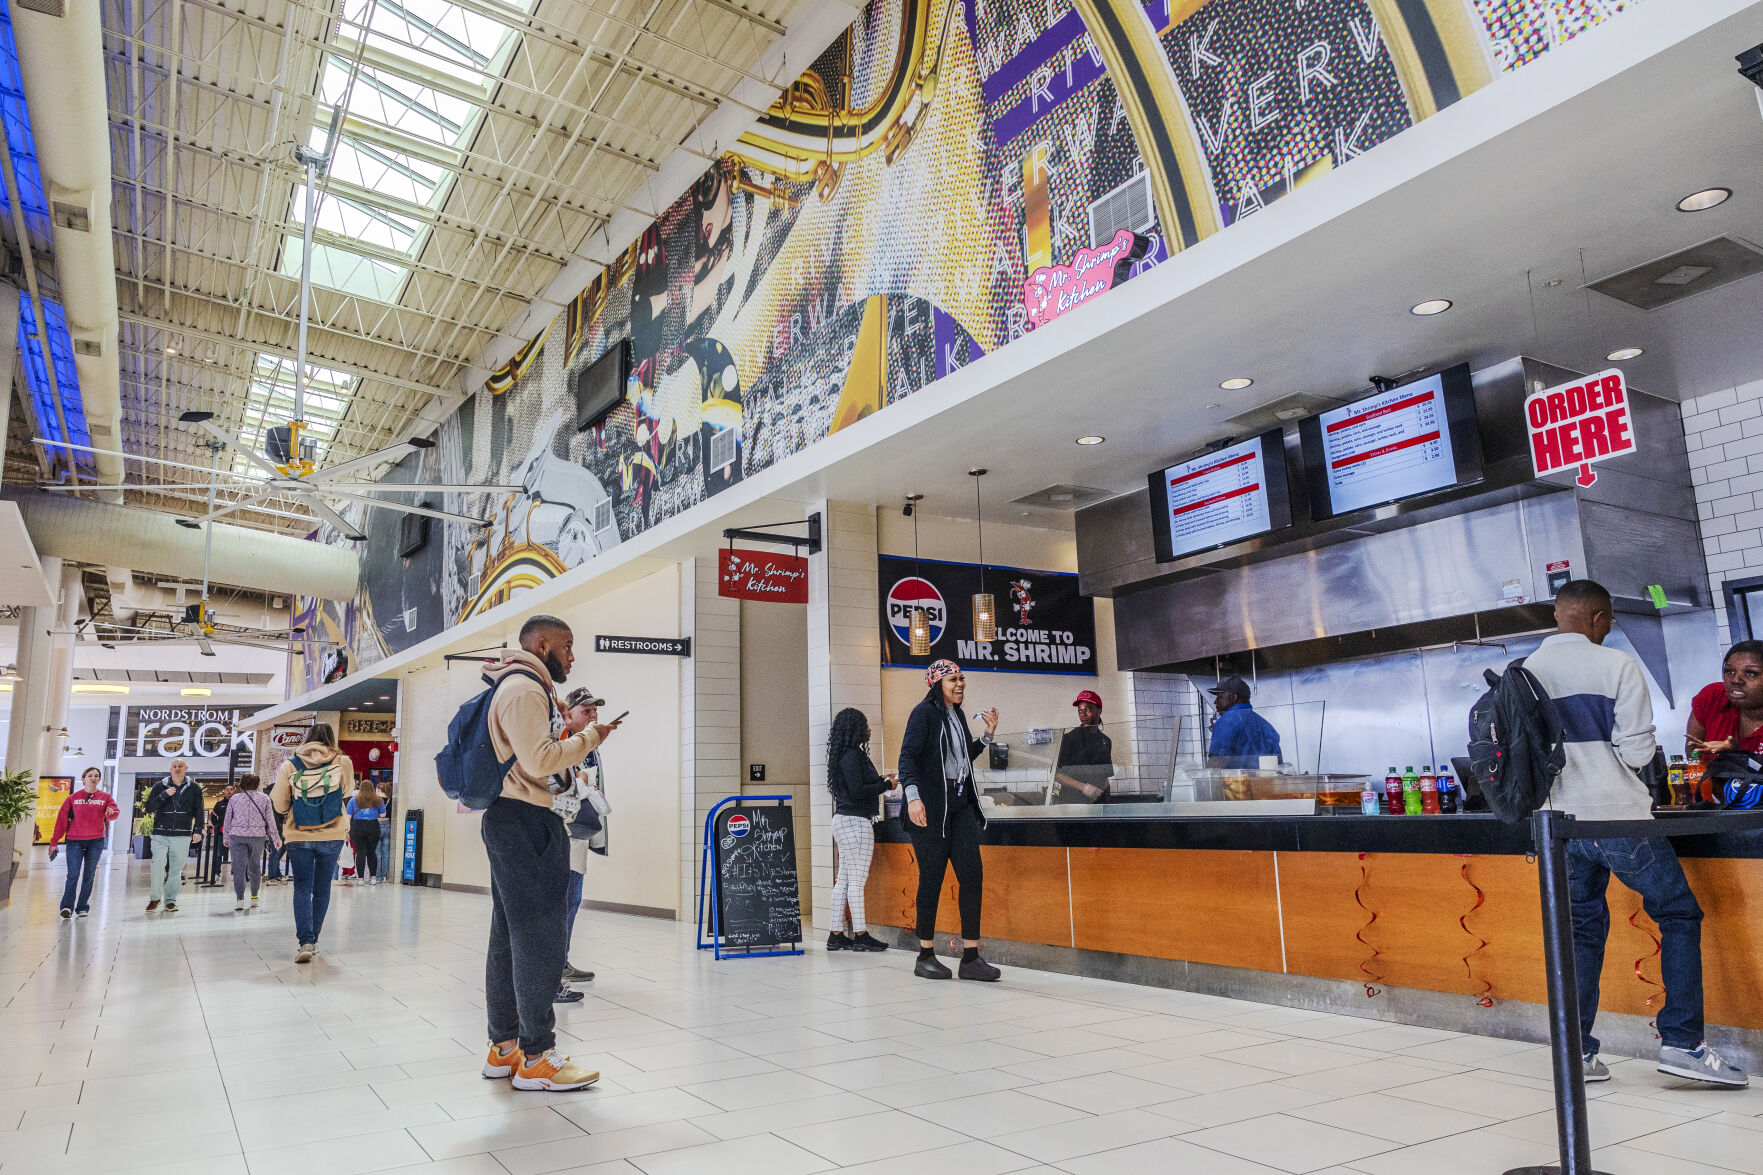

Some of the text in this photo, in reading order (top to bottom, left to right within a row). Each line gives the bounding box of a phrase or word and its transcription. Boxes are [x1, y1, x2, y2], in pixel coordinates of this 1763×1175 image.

[1048, 236, 1129, 292] Mr. Shrimp's
[1057, 280, 1106, 315] Kitchen
[1381, 397, 1398, 406] Kitchen
[1399, 392, 1413, 400] Menu
[1528, 374, 1624, 428] ORDER
[1532, 407, 1632, 472] HERE
[742, 562, 805, 582] Mr. Shrimp's
[746, 577, 786, 592] Kitchen
[611, 640, 673, 651] RESTROOMS
[994, 627, 1073, 644] LCOME TO
[957, 640, 1090, 664] MR. SHRIMP
[140, 710, 229, 721] NORDSTROM
[136, 710, 254, 757] rack
